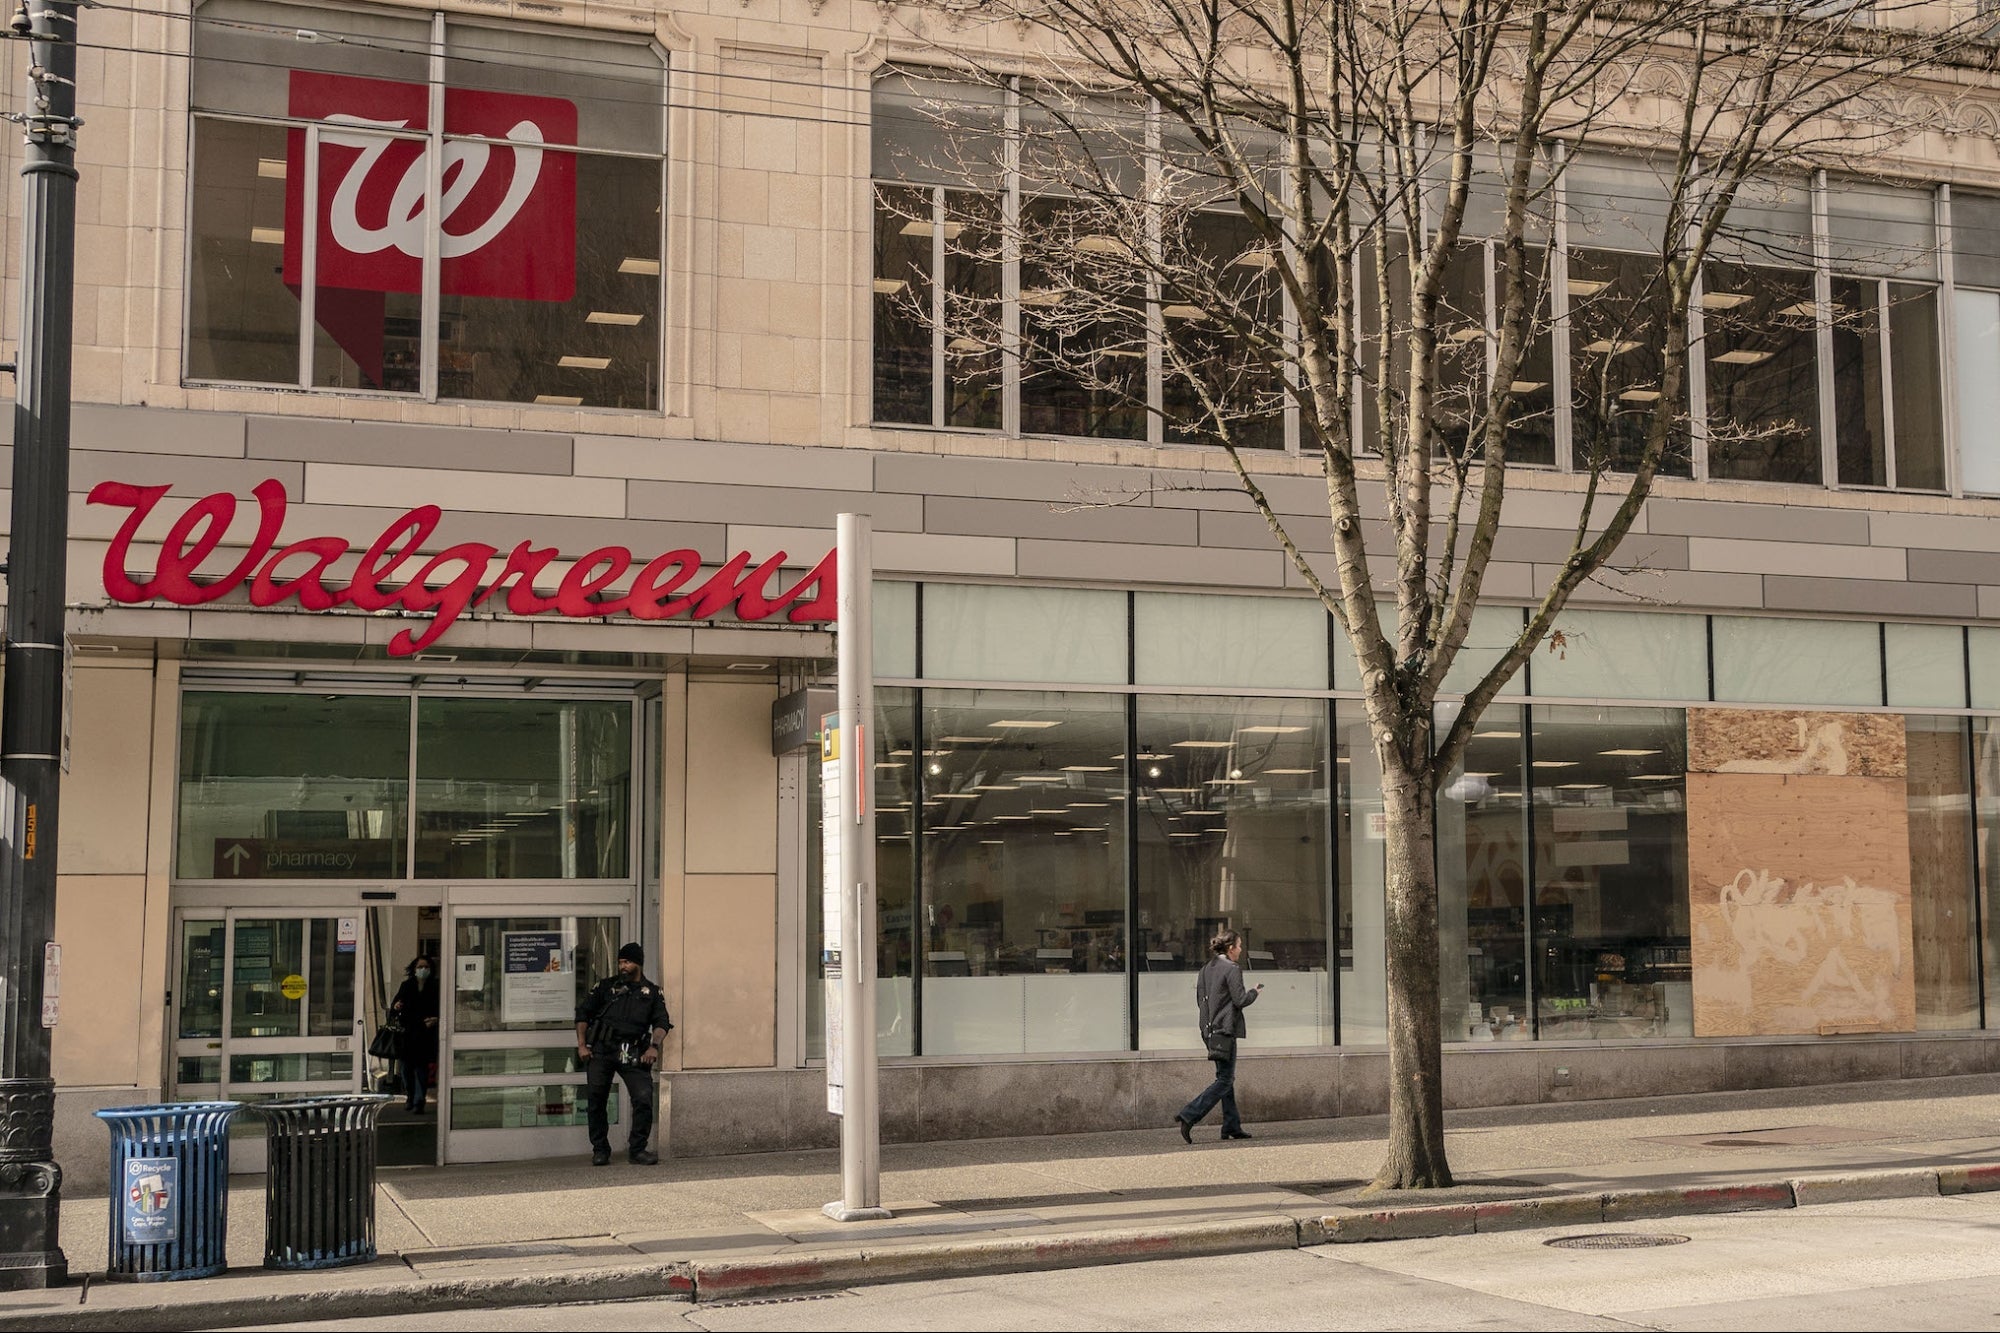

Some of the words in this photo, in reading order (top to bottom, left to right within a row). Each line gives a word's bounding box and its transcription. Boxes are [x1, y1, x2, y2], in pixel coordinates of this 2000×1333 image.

[316, 112, 544, 260] W
[86, 478, 838, 657] Walgreens
[774, 707, 805, 736] PHARMACY
[266, 847, 358, 870] pharmacy
[143, 1164, 172, 1173] Recycle
